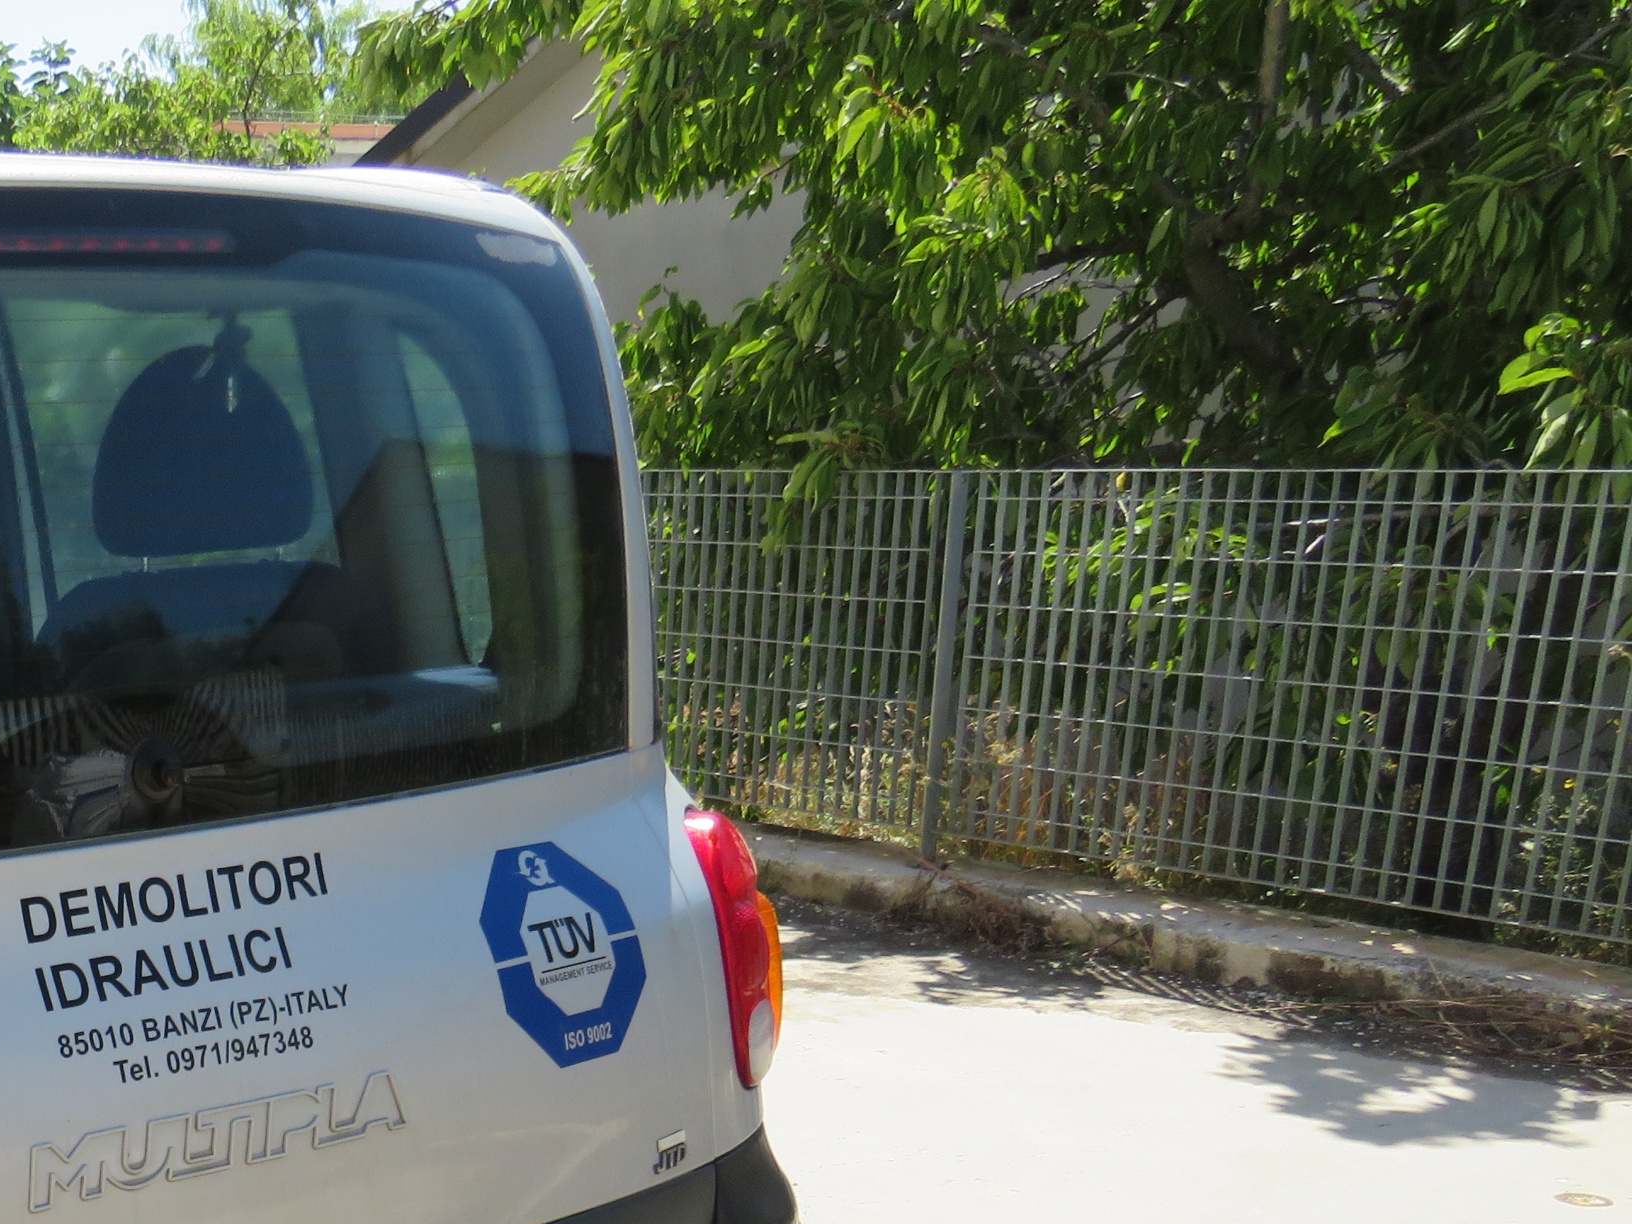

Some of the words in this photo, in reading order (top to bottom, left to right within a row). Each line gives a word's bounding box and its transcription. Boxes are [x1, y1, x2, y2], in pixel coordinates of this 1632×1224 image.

[20, 852, 328, 944] DEMOLITORI
[35, 926, 293, 1012] IDRAULICI
[528, 912, 596, 963] TÜV
[539, 967, 586, 986] MANAGEMENT
[586, 960, 613, 975] SERVICE
[57, 1023, 135, 1059] 85010
[142, 1005, 223, 1042] BANZI
[229, 984, 349, 1030] (PZ)-ITALY
[564, 1029, 585, 1050] ISO
[586, 1021, 613, 1044] 9002
[113, 1055, 159, 1084] Tel.
[166, 1026, 314, 1075] 0971/947348
[28, 1069, 408, 1214] MULTIPLA
